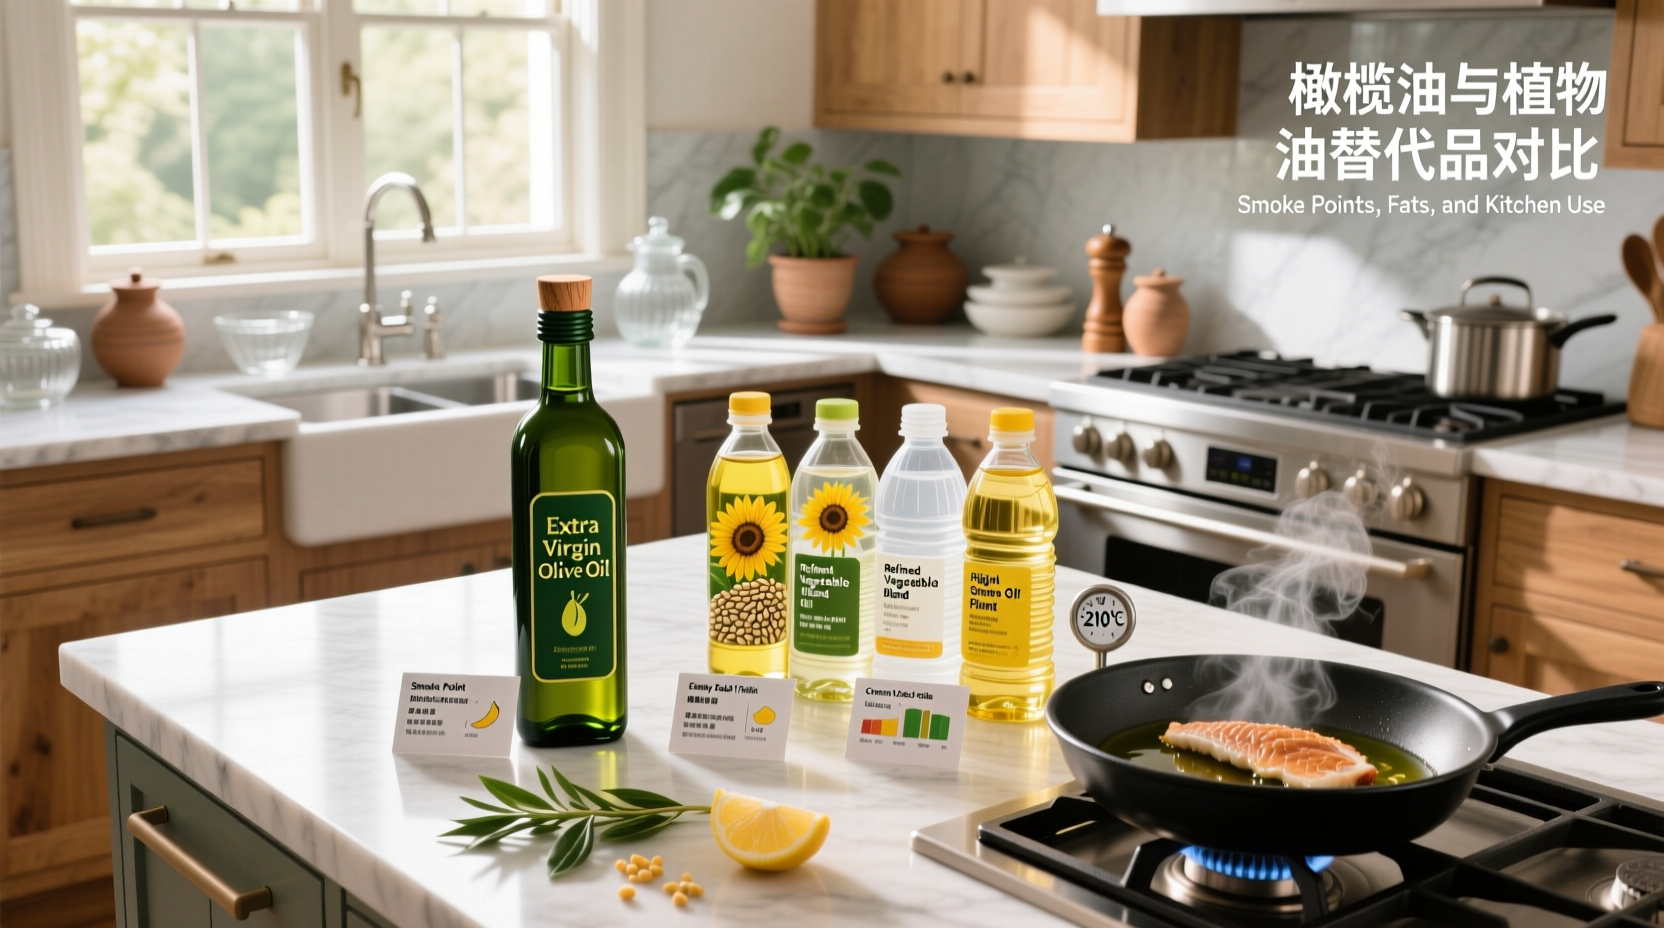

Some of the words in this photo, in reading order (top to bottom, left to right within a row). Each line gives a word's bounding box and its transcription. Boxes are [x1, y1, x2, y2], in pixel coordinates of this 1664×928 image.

[546, 516, 599, 535] Extra
[542, 538, 601, 561] Virgin
[538, 561, 583, 579] Olive
[585, 559, 610, 577] Oil
[884, 563, 921, 575] Refined
